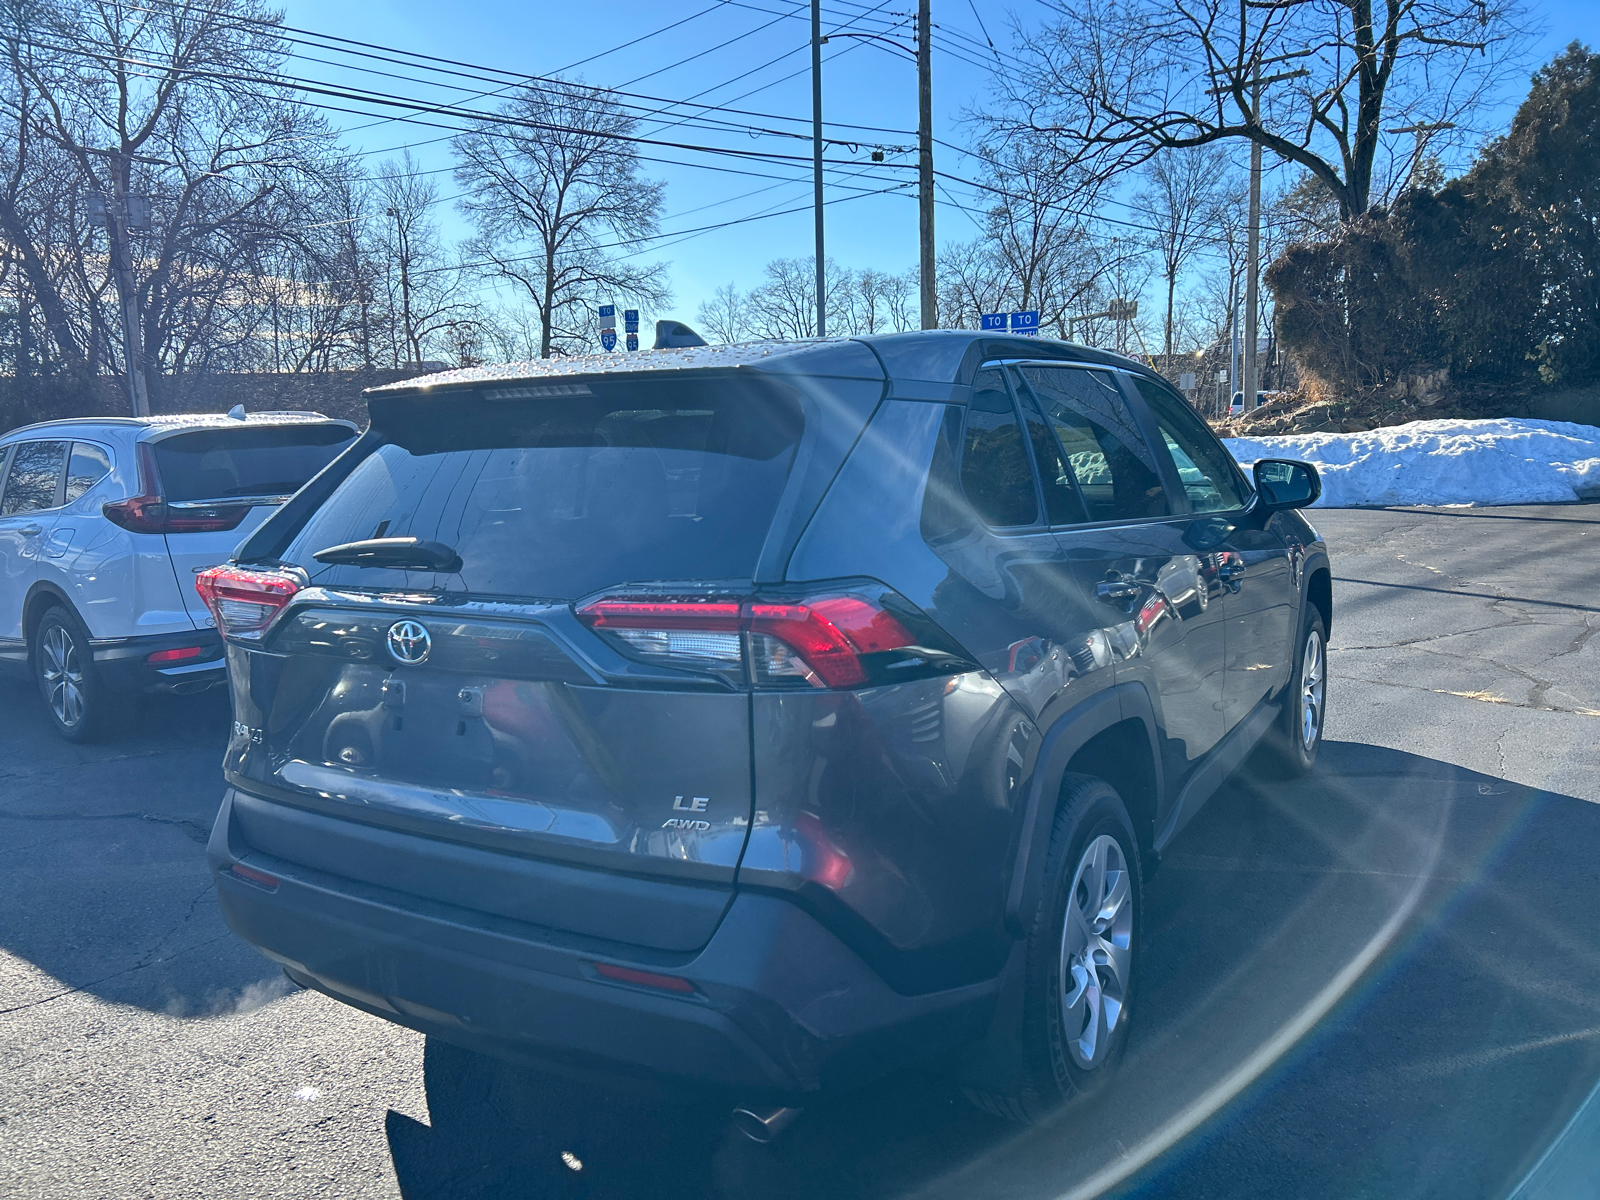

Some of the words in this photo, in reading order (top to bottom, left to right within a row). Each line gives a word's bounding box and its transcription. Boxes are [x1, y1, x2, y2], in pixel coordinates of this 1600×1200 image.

[603, 307, 611, 315] TO
[628, 312, 635, 320] TO
[988, 316, 1001, 326] TO
[1018, 314, 1032, 325] TO
[603, 336, 615, 347] 95
[628, 341, 637, 351] 95
[235, 720, 263, 744] RAV4
[673, 795, 710, 812] LE
[661, 818, 711, 831] AWD
